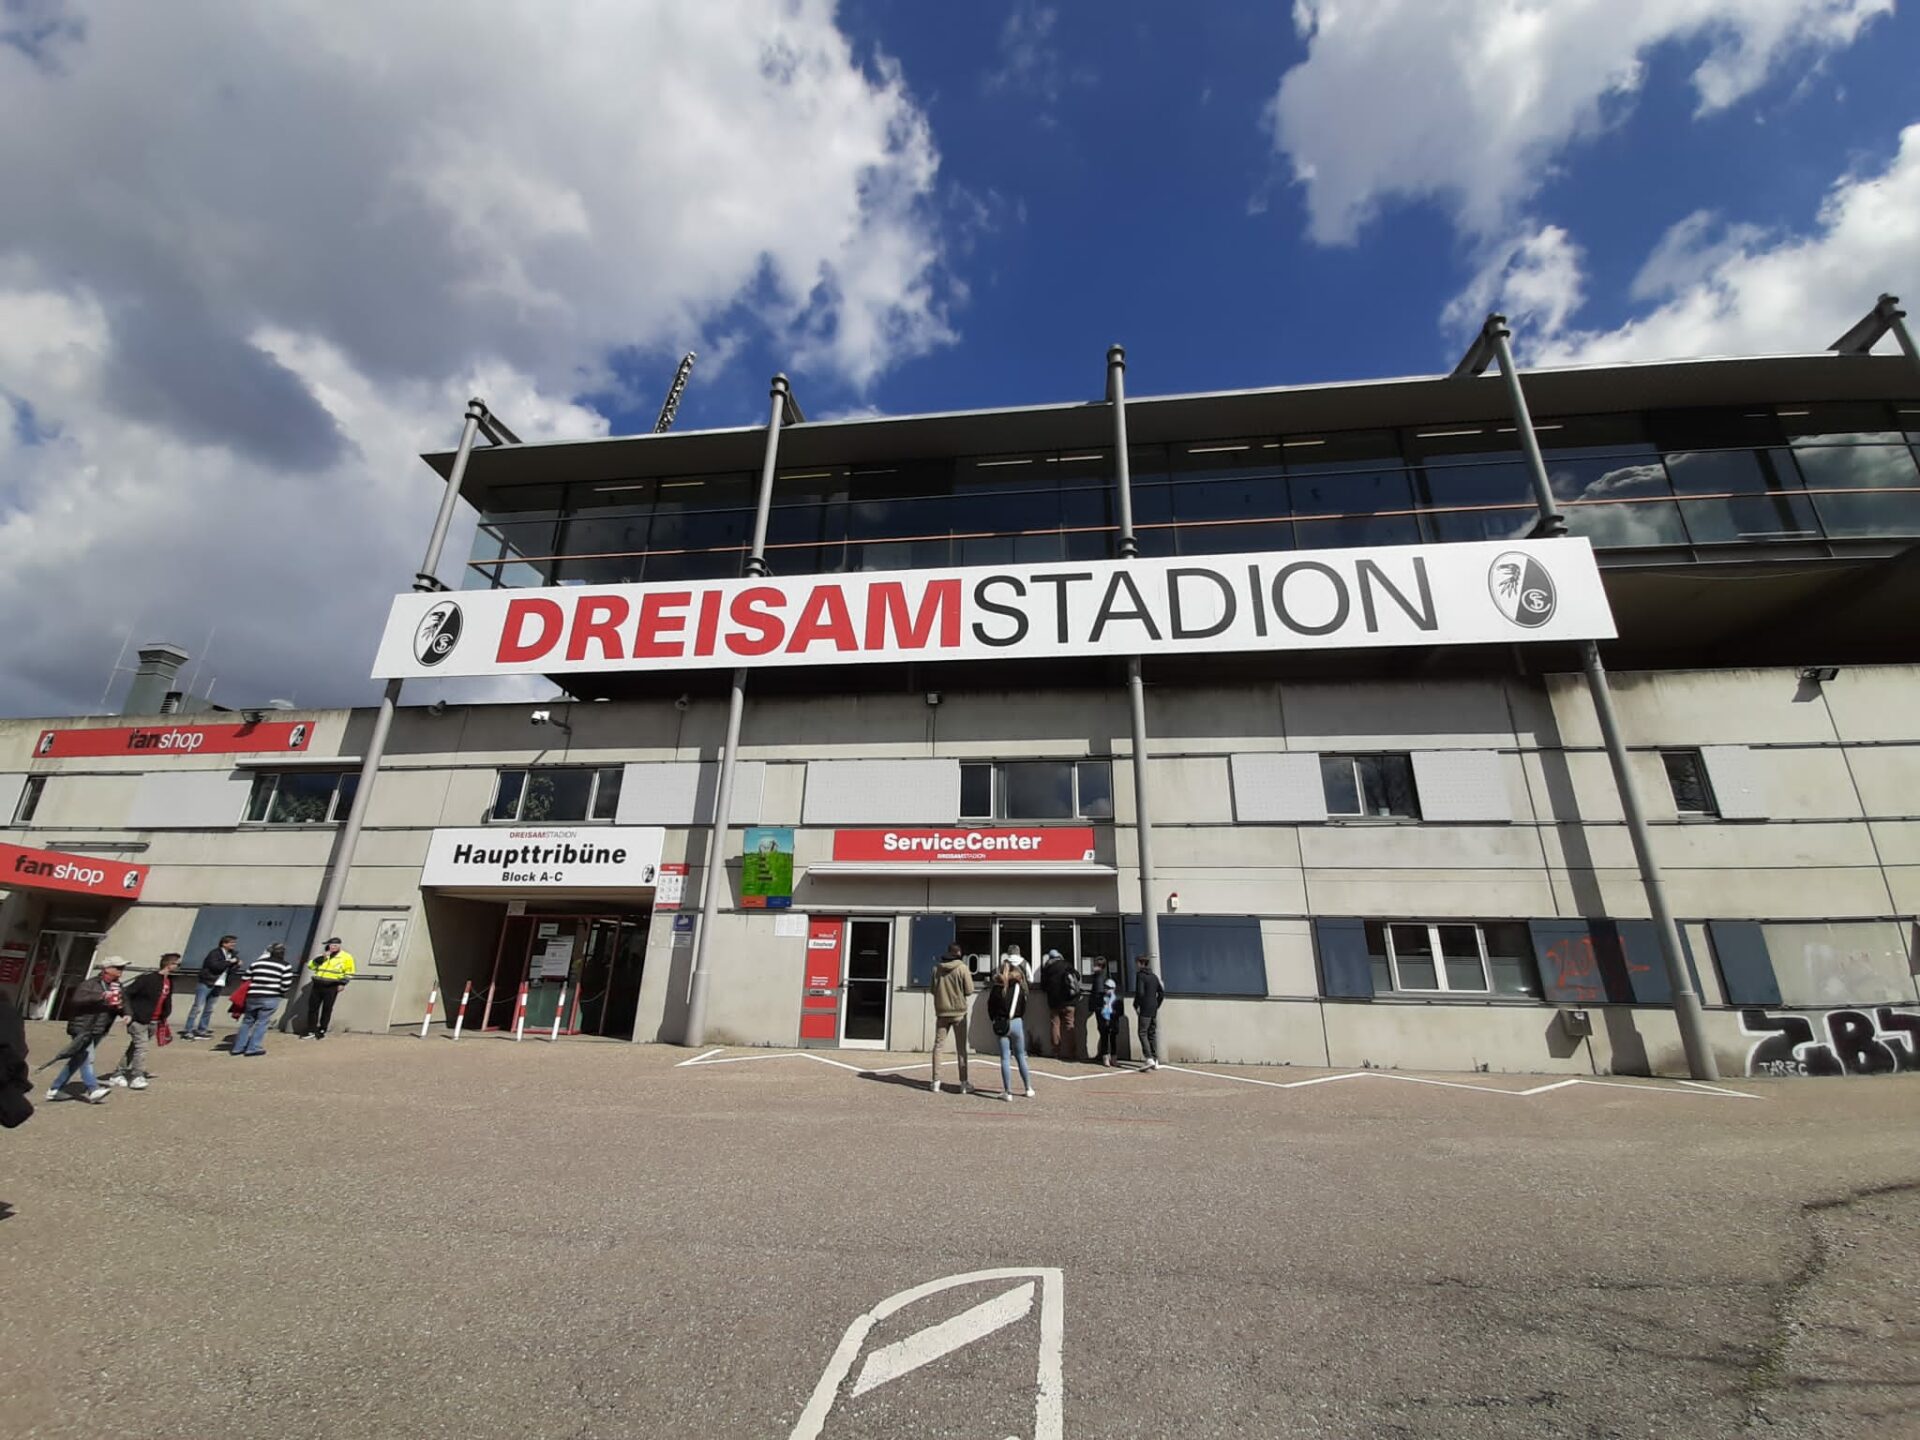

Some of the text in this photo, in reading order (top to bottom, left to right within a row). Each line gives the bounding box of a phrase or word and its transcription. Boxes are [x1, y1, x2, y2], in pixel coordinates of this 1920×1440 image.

[495, 555, 1440, 664] DREISAMSTADION
[128, 728, 204, 750] fanshop
[883, 832, 1042, 850] ServiceCenter
[452, 843, 627, 869] Haupttribüne
[14, 854, 105, 885] fanshop
[501, 871, 563, 882] Block A-C
